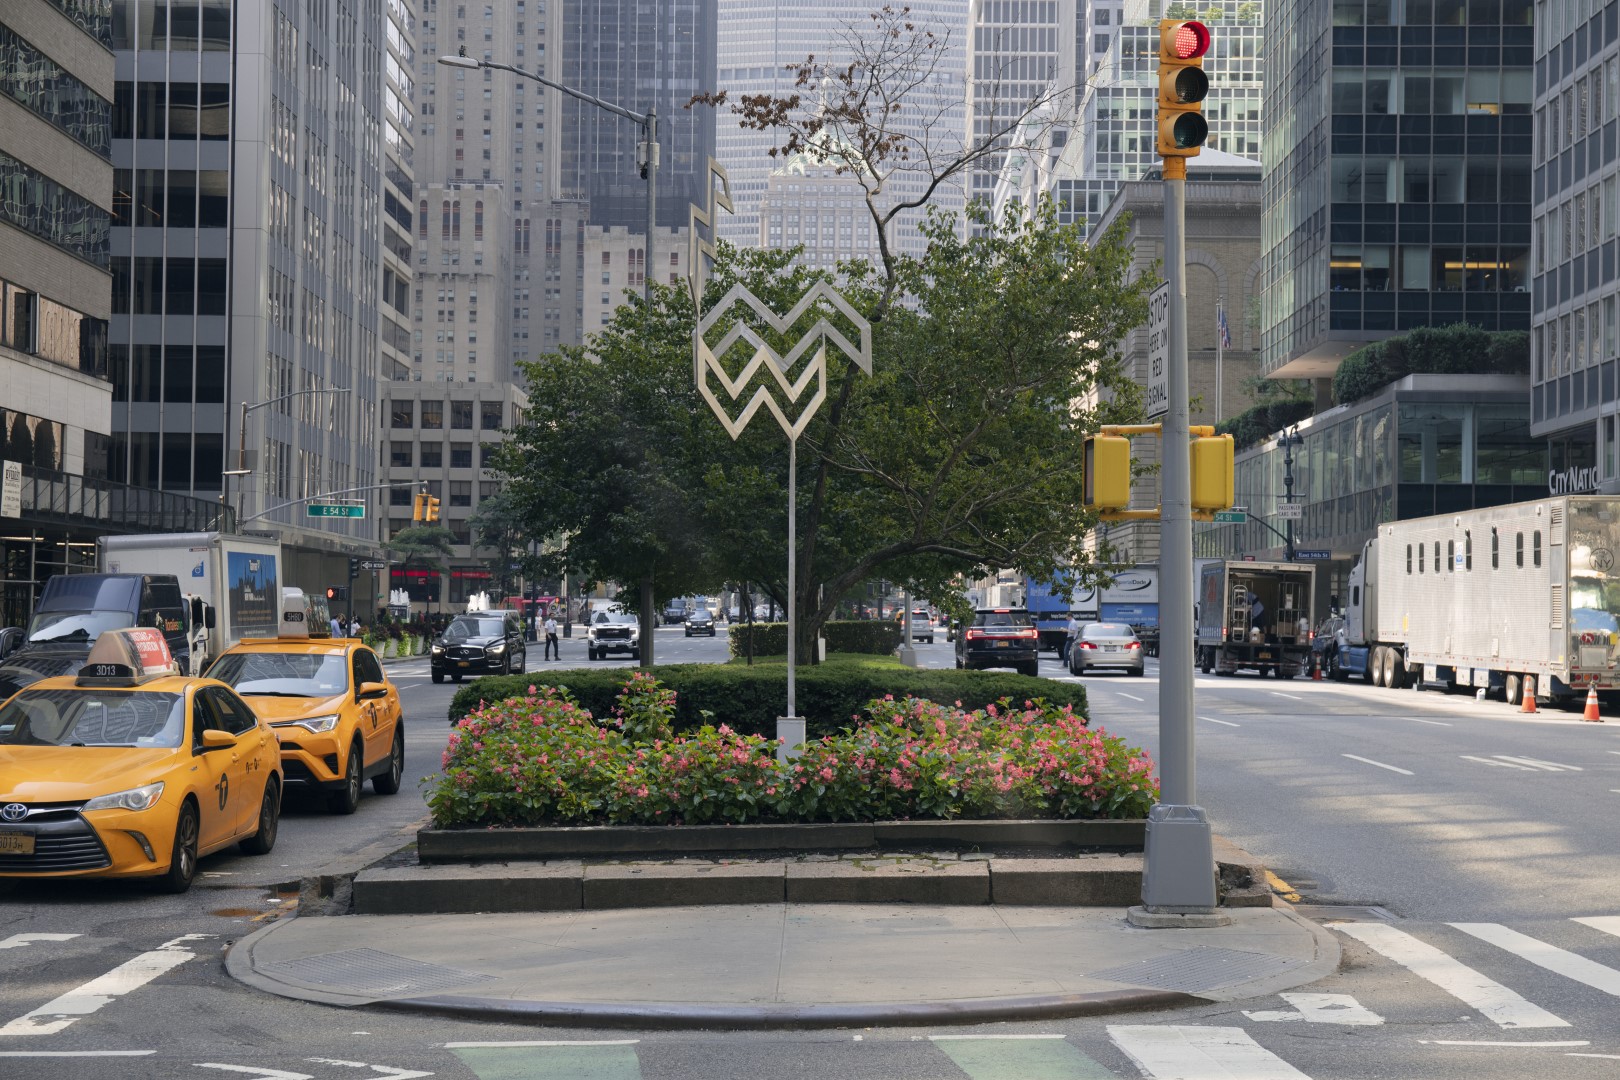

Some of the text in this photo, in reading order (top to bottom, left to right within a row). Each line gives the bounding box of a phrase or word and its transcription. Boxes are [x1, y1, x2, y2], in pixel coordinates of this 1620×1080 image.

[1149, 292, 1168, 328] STOP
[1161, 327, 1168, 348] ON
[1152, 357, 1162, 379] RED
[1148, 382, 1167, 406] SIGNAL
[323, 507, 349, 516] E 54 St
[1215, 513, 1233, 521] 54 St
[1594, 559, 1611, 569] NY
[96, 665, 116, 676] 3D13
